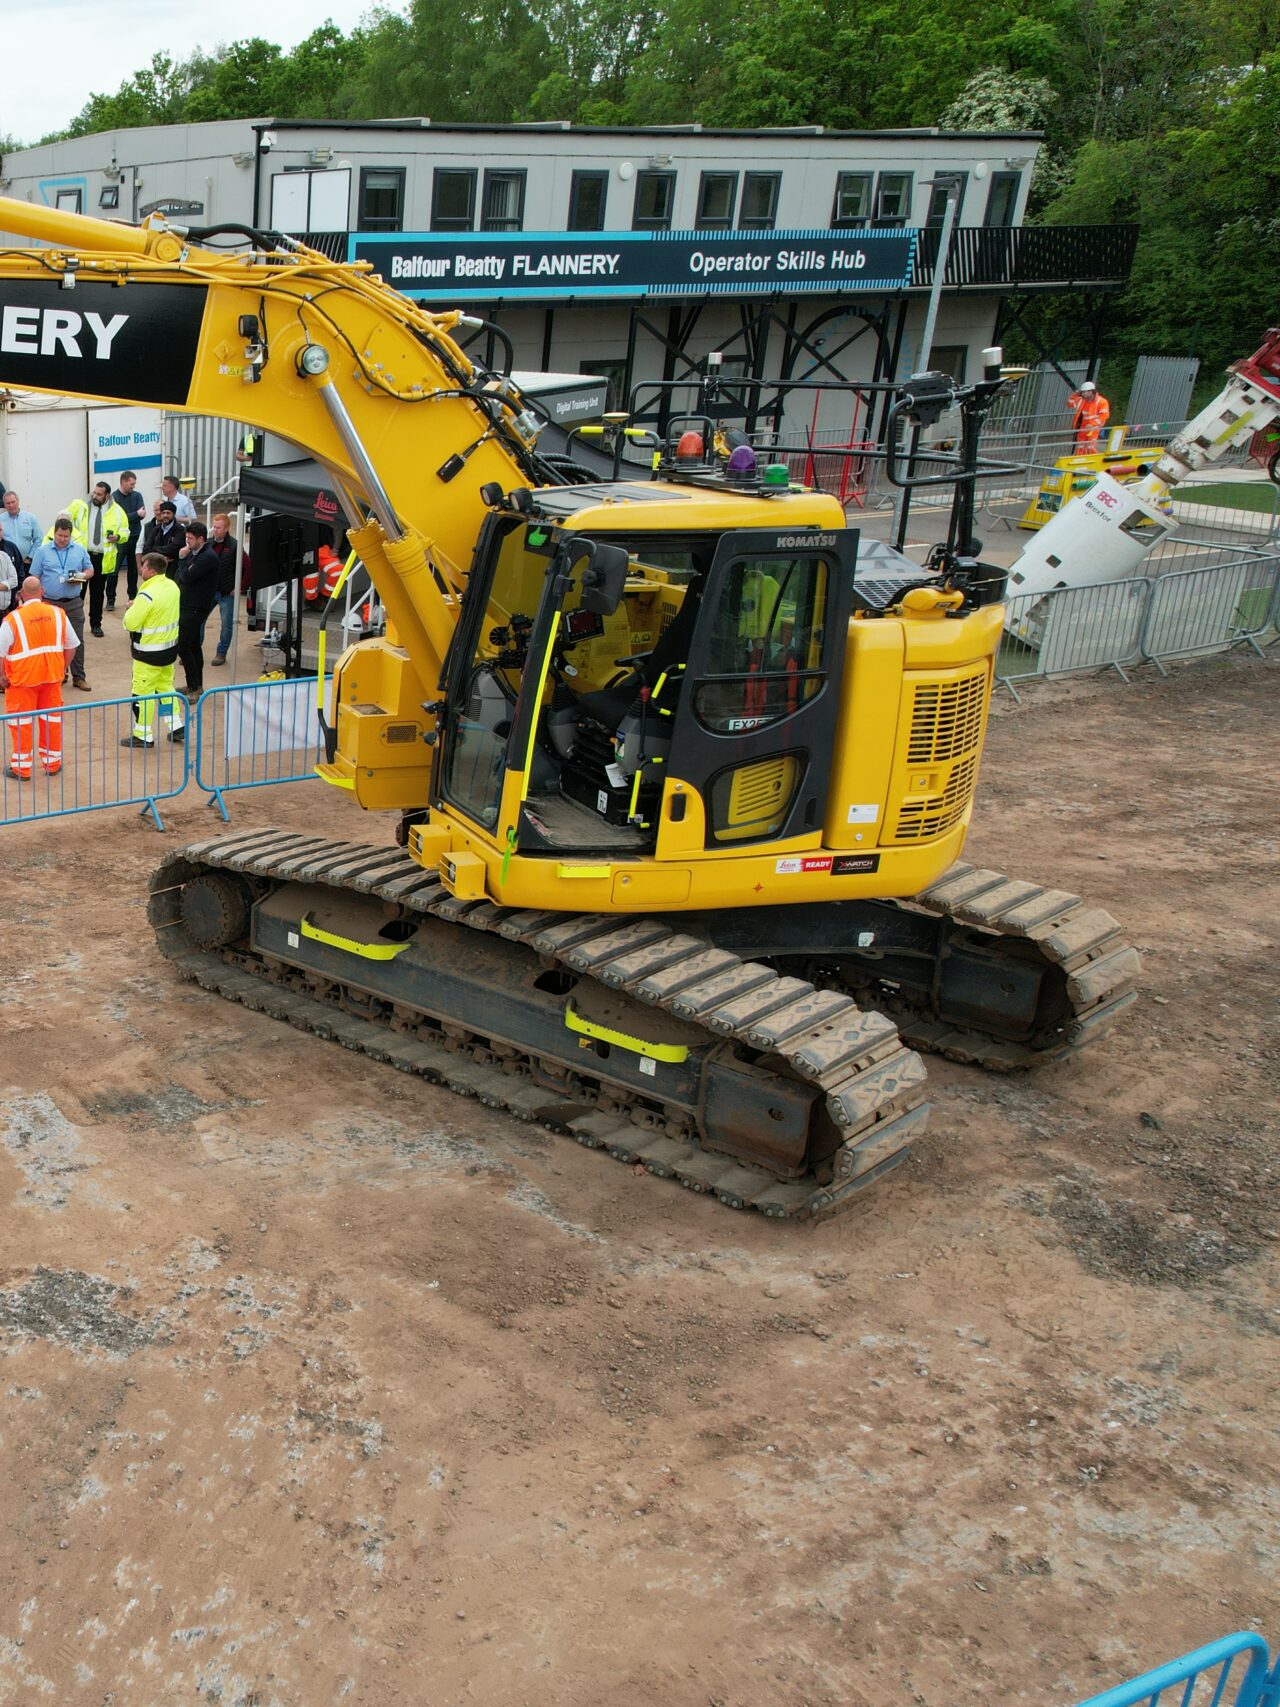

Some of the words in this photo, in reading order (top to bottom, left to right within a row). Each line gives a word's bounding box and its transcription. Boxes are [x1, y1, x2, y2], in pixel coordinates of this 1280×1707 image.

[391, 256, 451, 278] Balfour
[454, 255, 506, 279] Beatty
[689, 251, 771, 277] Operator
[776, 250, 826, 271] Skills
[830, 250, 866, 270] Hub
[556, 402, 572, 415] Digital
[572, 399, 589, 411] Training
[589, 397, 599, 407] Unit
[99, 434, 131, 447] Balfour
[133, 431, 161, 444] Beatty
[313, 491, 338, 513] Leica
[1096, 491, 1117, 508] BRC
[1085, 501, 1111, 522] Brexfor
[777, 533, 837, 548] KOMATSU
